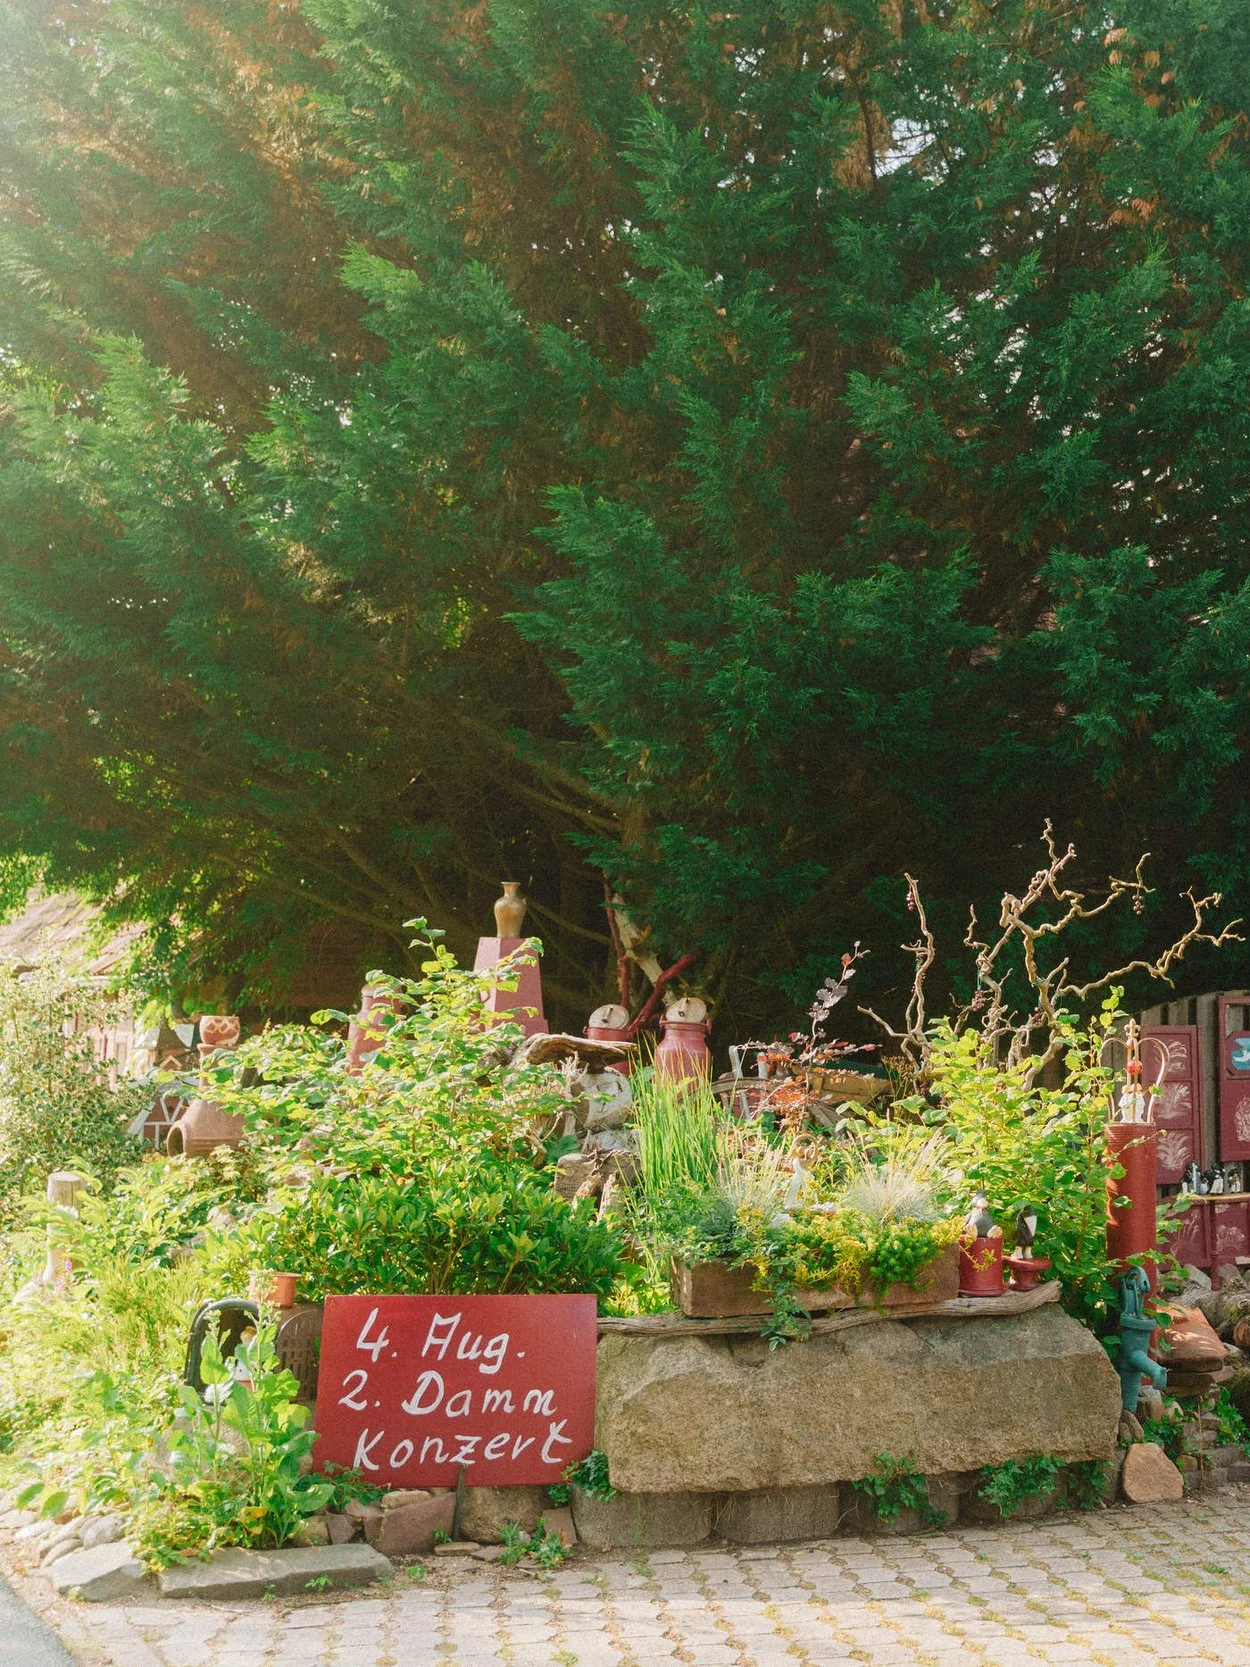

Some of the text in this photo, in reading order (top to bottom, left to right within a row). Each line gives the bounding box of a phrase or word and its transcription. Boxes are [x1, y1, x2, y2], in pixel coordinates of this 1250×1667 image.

[355, 1307, 526, 1375] 4. Aug.
[338, 1369, 558, 1418] 2. Damm
[353, 1418, 573, 1471] Konzert
